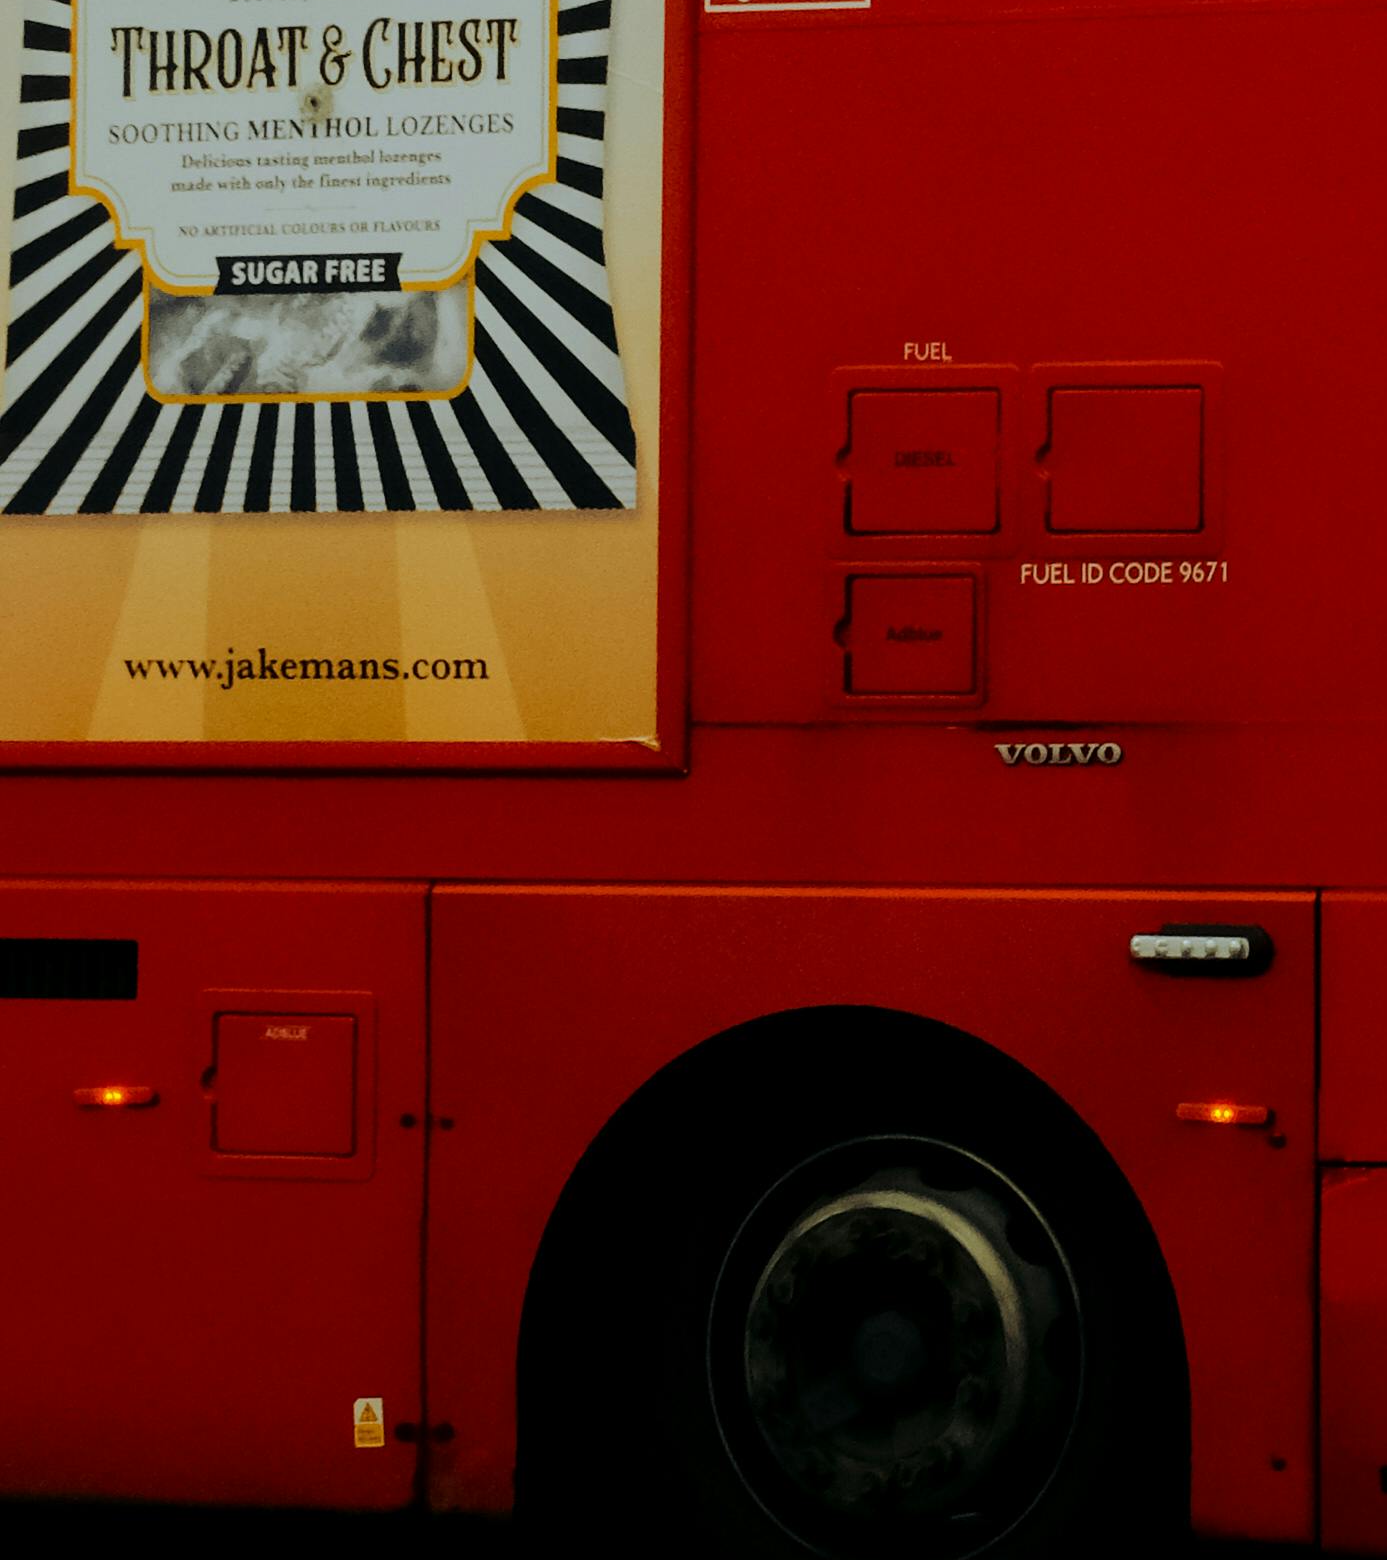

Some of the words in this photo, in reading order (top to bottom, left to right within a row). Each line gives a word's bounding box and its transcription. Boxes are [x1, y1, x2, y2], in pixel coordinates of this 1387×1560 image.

[111, 26, 309, 99] THROAT
[319, 24, 353, 86] &
[362, 17, 519, 90] CHEST
[108, 122, 240, 144] SOOTHING
[248, 116, 378, 140] MENTHOL
[386, 113, 514, 136] LOZENGES
[182, 154, 252, 169] Delicious
[257, 153, 309, 170] tasting
[314, 150, 375, 165] menthol
[379, 148, 442, 166] lozenges
[171, 178, 212, 192] made
[218, 177, 251, 190] with
[255, 176, 285, 193] only
[292, 176, 314, 189] the
[320, 173, 361, 188] finest
[366, 171, 452, 191] ingredients
[179, 225, 199, 238] NO
[204, 223, 278, 237] ARTIFICIAL
[350, 221, 369, 233] OR
[374, 219, 441, 233] FLAVOURS
[231, 259, 318, 286] SUGAR
[325, 257, 386, 284] FREE
[904, 342, 952, 361] FUEL
[1021, 563, 1075, 584] FUEL
[1081, 563, 1103, 583] ID
[1109, 563, 1173, 583] CODE
[1179, 561, 1228, 582] 9671
[124, 647, 489, 690] www.jakemans.com
[995, 742, 1122, 765] VOLVO
